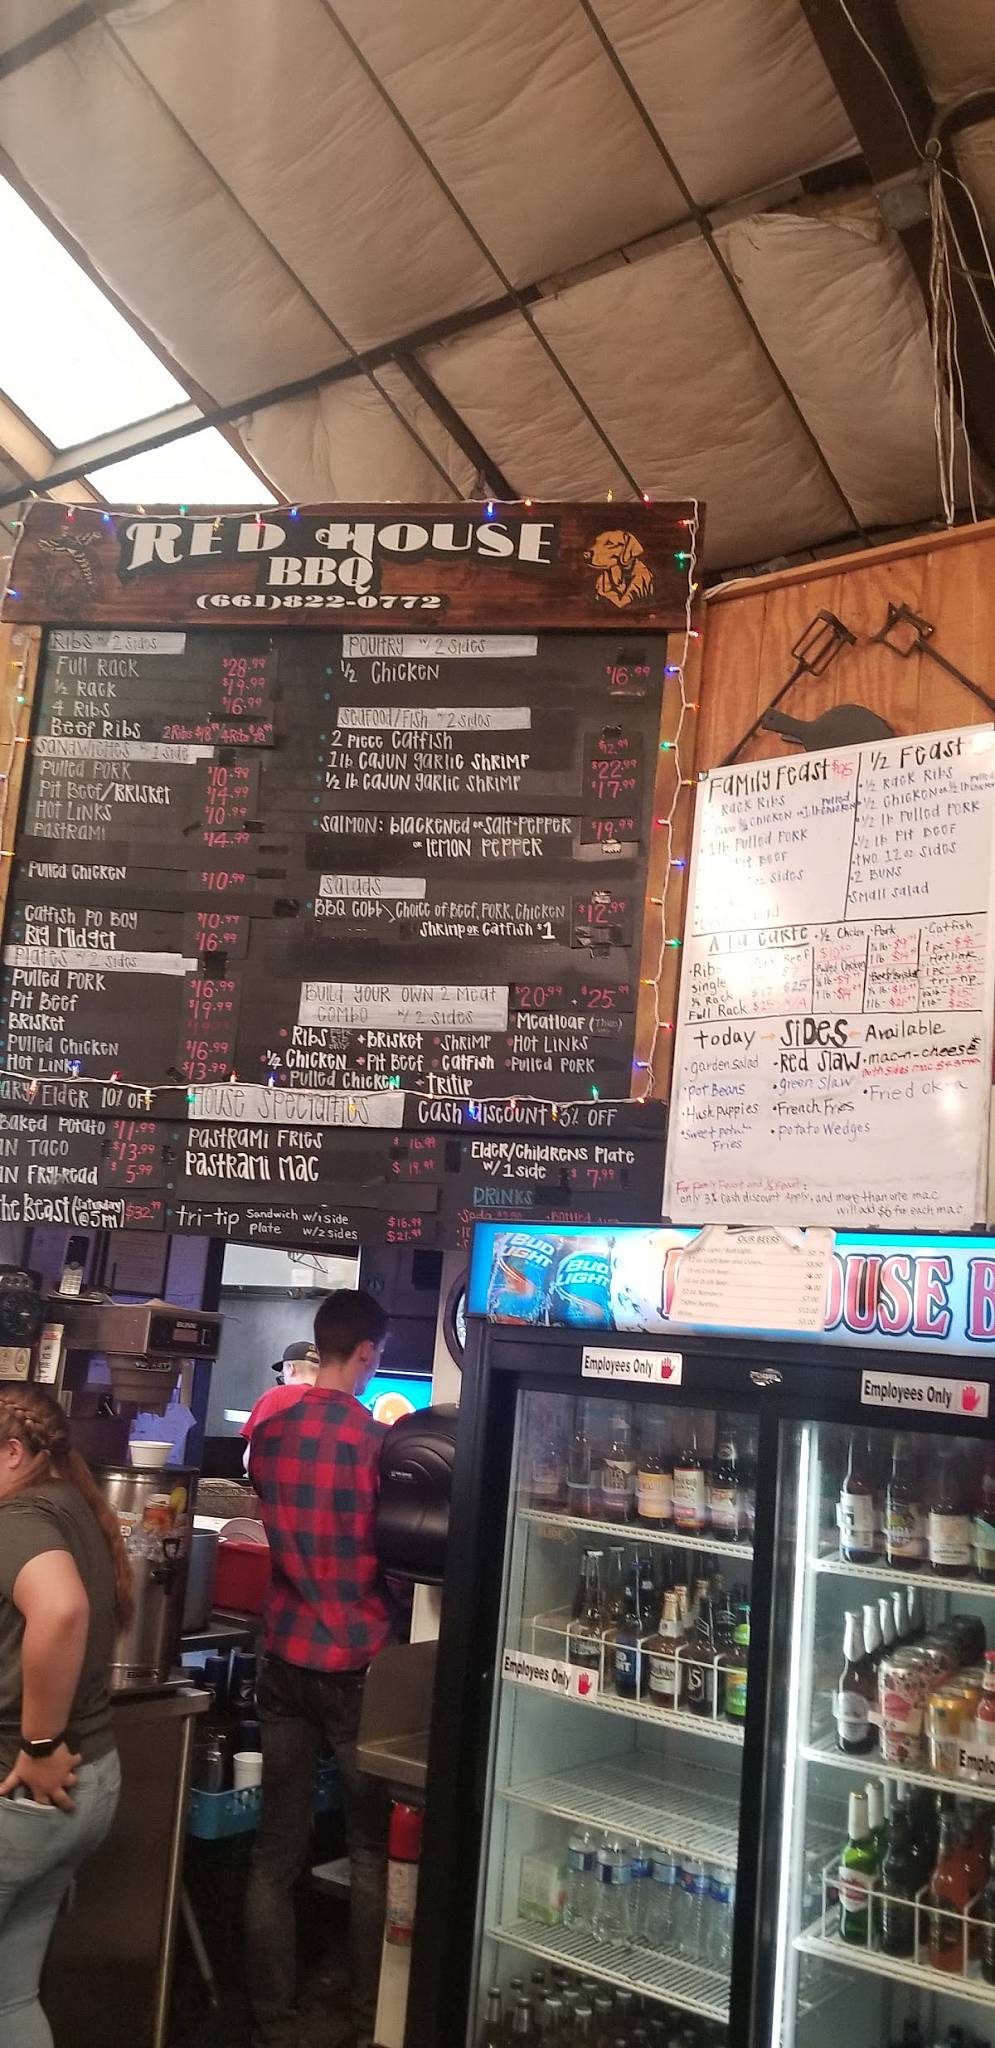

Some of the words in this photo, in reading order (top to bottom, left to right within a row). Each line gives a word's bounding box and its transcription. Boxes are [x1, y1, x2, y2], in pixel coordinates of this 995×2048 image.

[125, 522, 287, 571] RED
[314, 521, 555, 564] HOUSE
[266, 556, 374, 595] BBQ
[196, 593, 442, 610] (661)822-0772
[349, 636, 404, 654] Poultry
[56, 656, 88, 677] Full
[97, 659, 140, 678] Rack
[371, 661, 440, 684] Chicken
[77, 682, 117, 697] Rack
[52, 702, 63, 717] 4
[74, 701, 110, 718] Ribs
[51, 718, 97, 736] Beef
[103, 721, 141, 739] Ribs
[331, 730, 342, 747] 2
[392, 732, 453, 750] Catfish
[900, 740, 962, 768] Feast
[93, 762, 131, 780] Pork
[709, 770, 770, 802] Family
[776, 758, 829, 795] Feast
[883, 775, 914, 790] Rack
[924, 767, 953, 781] Ribs
[40, 780, 63, 798] Pit
[36, 801, 63, 819] Hot
[67, 803, 113, 822] Links
[34, 822, 106, 840] Pastrami
[28, 861, 66, 879] Pulled
[72, 864, 127, 880] Chicken
[24, 904, 76, 924] Catfish
[315, 899, 346, 917] BBQ
[516, 903, 565, 920] Chicken
[25, 924, 50, 946] Big
[58, 926, 117, 950] Midget
[482, 922, 534, 937] Catfish
[12, 970, 59, 988] Pulled
[68, 972, 106, 991] Pork
[10, 990, 33, 1009] Pit
[39, 992, 80, 1012] Beef
[440, 986, 451, 1001] 2
[8, 1012, 66, 1032] Brisket
[416, 1009, 425, 1023] 2
[689, 1007, 711, 1020] Full
[718, 1004, 747, 1016] Rack
[292, 1027, 327, 1045] Ribs
[513, 1036, 539, 1051] Hot
[544, 1036, 588, 1051] Links
[694, 1027, 756, 1050] today
[781, 1018, 848, 1047] Sides
[865, 1021, 946, 1042] Available
[7, 1034, 52, 1054] Pulled
[60, 1038, 119, 1056] Chicken
[6, 1054, 32, 1070] Hot
[286, 1050, 347, 1069] Chicken
[367, 1054, 386, 1071] Pit
[391, 1054, 424, 1071] Beef
[442, 1054, 494, 1070] Catfish
[511, 1056, 552, 1071] Pulled
[561, 1058, 595, 1072] Pork
[779, 1054, 808, 1073] Red
[818, 1051, 860, 1072] Slaw
[290, 1071, 335, 1087] Pulled
[711, 1084, 746, 1096] Beans
[870, 1083, 914, 1101] Fried
[419, 1100, 463, 1123] Cash
[686, 1106, 714, 1120] Hush
[778, 1101, 820, 1115] French
[825, 1098, 855, 1115] Fries
[58, 1117, 105, 1134] Potato
[27, 1138, 69, 1156] Taco
[188, 1126, 269, 1149] Pastrami
[278, 1131, 322, 1150] Fries
[594, 1145, 635, 1164] Plate
[186, 1150, 271, 1180] Pastrami
[279, 1153, 319, 1182] Mac
[474, 1186, 534, 1206] Drinks
[24, 1192, 70, 1227] Beast
[176, 1205, 240, 1234] tri-tip
[246, 1209, 298, 1221] Sandwich
[511, 1233, 555, 1255] BUD
[503, 1245, 553, 1267] LIGHT
[566, 1259, 609, 1273] BUD
[557, 1273, 609, 1288] LIGHT
[584, 1354, 631, 1374] Employees
[632, 1359, 654, 1378] Only
[863, 1379, 926, 1401] Employees
[926, 1387, 953, 1408] Only
[504, 1656, 550, 1681] Employees
[552, 1668, 572, 1690] Only
